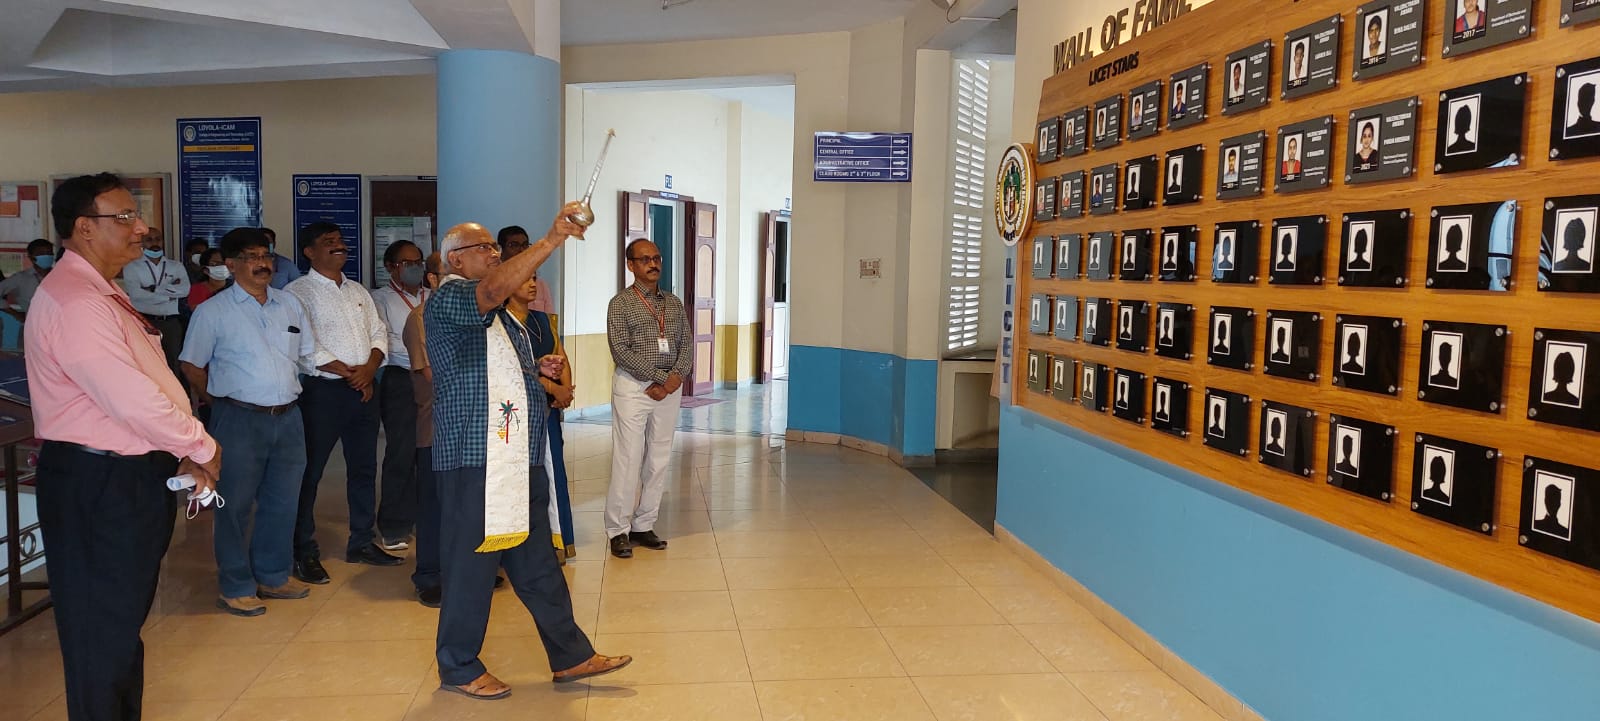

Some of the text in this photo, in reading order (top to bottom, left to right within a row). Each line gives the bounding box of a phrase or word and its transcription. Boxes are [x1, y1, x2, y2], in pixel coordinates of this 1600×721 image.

[1053, 27, 1093, 75] WALL
[1100, 8, 1129, 51] OF
[1462, 29, 1475, 39] 2017
[1088, 51, 1140, 86] LICET STARS
